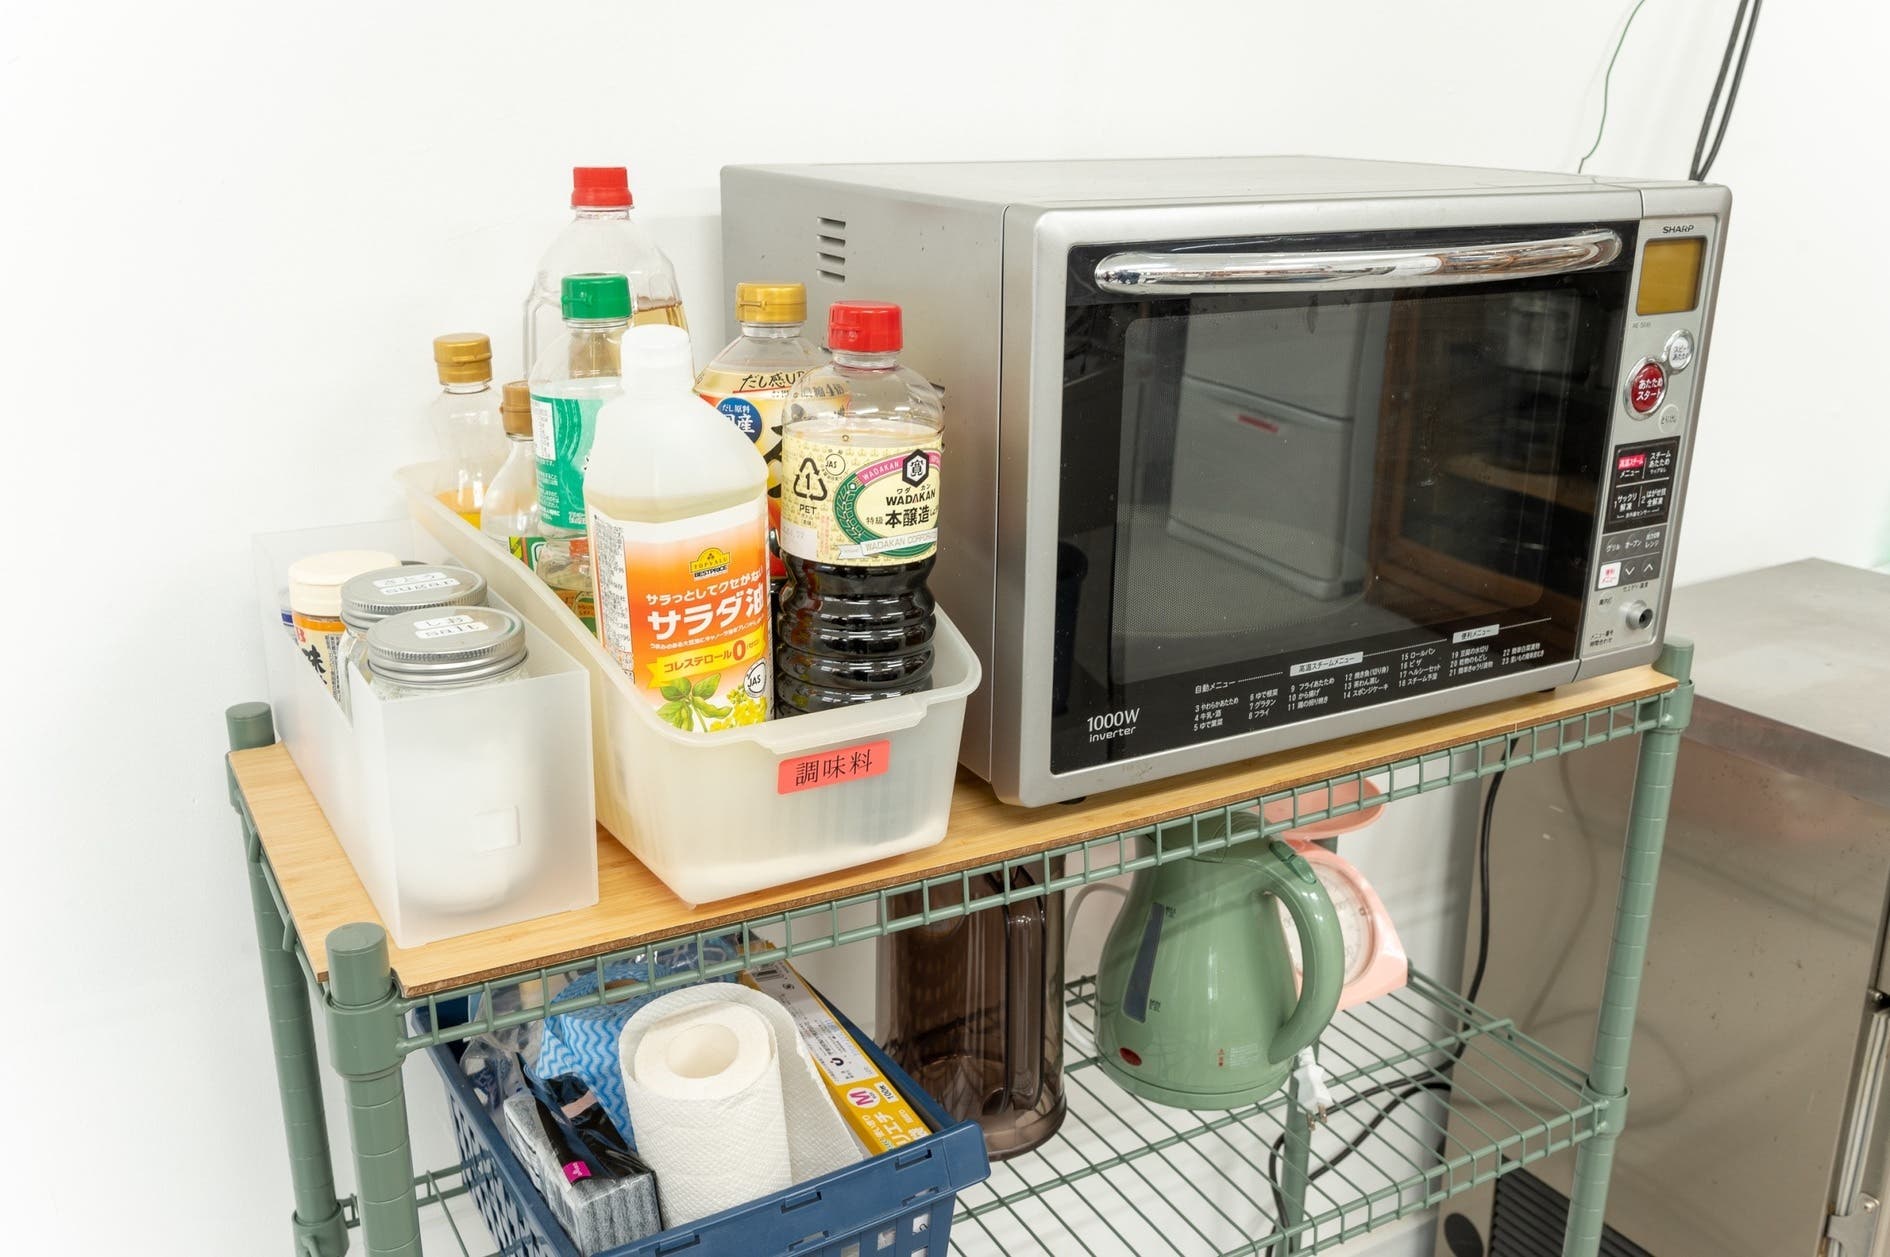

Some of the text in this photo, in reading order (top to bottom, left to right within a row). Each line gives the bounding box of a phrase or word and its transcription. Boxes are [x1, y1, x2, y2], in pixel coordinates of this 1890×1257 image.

[1662, 224, 1694, 234] SHARP
[1639, 377, 1663, 390] あたため
[1636, 388, 1661, 401] スタート
[722, 403, 750, 414] だし原料
[1650, 449, 1671, 460] スチーム
[826, 460, 838, 469] JAS
[1648, 458, 1671, 469] あたため
[862, 461, 899, 481] WADAKAN
[1619, 469, 1640, 478] メニュー
[886, 488, 936, 507] WADAKAN
[1617, 492, 1638, 504] サックリ
[1641, 495, 1646, 504] 2
[799, 504, 817, 515] PET
[885, 504, 930, 529] 本醸造
[865, 534, 905, 551] WADAKAN
[1606, 544, 1620, 553] グリル
[1644, 540, 1659, 549] レンジ
[694, 557, 728, 570] TOPVALU
[694, 565, 727, 578] BESTPRICE
[385, 578, 455, 595] sugar
[647, 582, 763, 640] サラダ油
[425, 623, 480, 638] salt
[1461, 628, 1492, 641] 便利メニュー
[1401, 647, 1436, 661] 15 ロールパン
[1452, 650, 1459, 659] 19
[1298, 656, 1356, 673] 高温スチームメニュー
[1400, 661, 1408, 670] 16
[1450, 659, 1458, 668] 20
[1345, 672, 1353, 681] 12
[1399, 663, 1441, 679] 17 ヘルシーセット
[1449, 668, 1456, 677] 21
[747, 673, 762, 688] JAS
[1290, 677, 1336, 693] 9 フライあたため
[1344, 681, 1352, 690] 13
[1194, 680, 1237, 695] 自動メニュー
[1343, 683, 1389, 699] 14 スポンジケーキ
[1288, 693, 1297, 702] 10
[1194, 704, 1200, 713] 3
[1254, 698, 1277, 710] グラタン
[1287, 702, 1295, 712] 11
[1087, 707, 1141, 732] 1000W
[1194, 714, 1200, 722] 4
[1254, 708, 1270, 719] フライ
[1193, 723, 1199, 732] 5
[1089, 726, 1137, 743] inverter
[795, 748, 873, 787] 調味料
[849, 1089, 875, 1107] M
